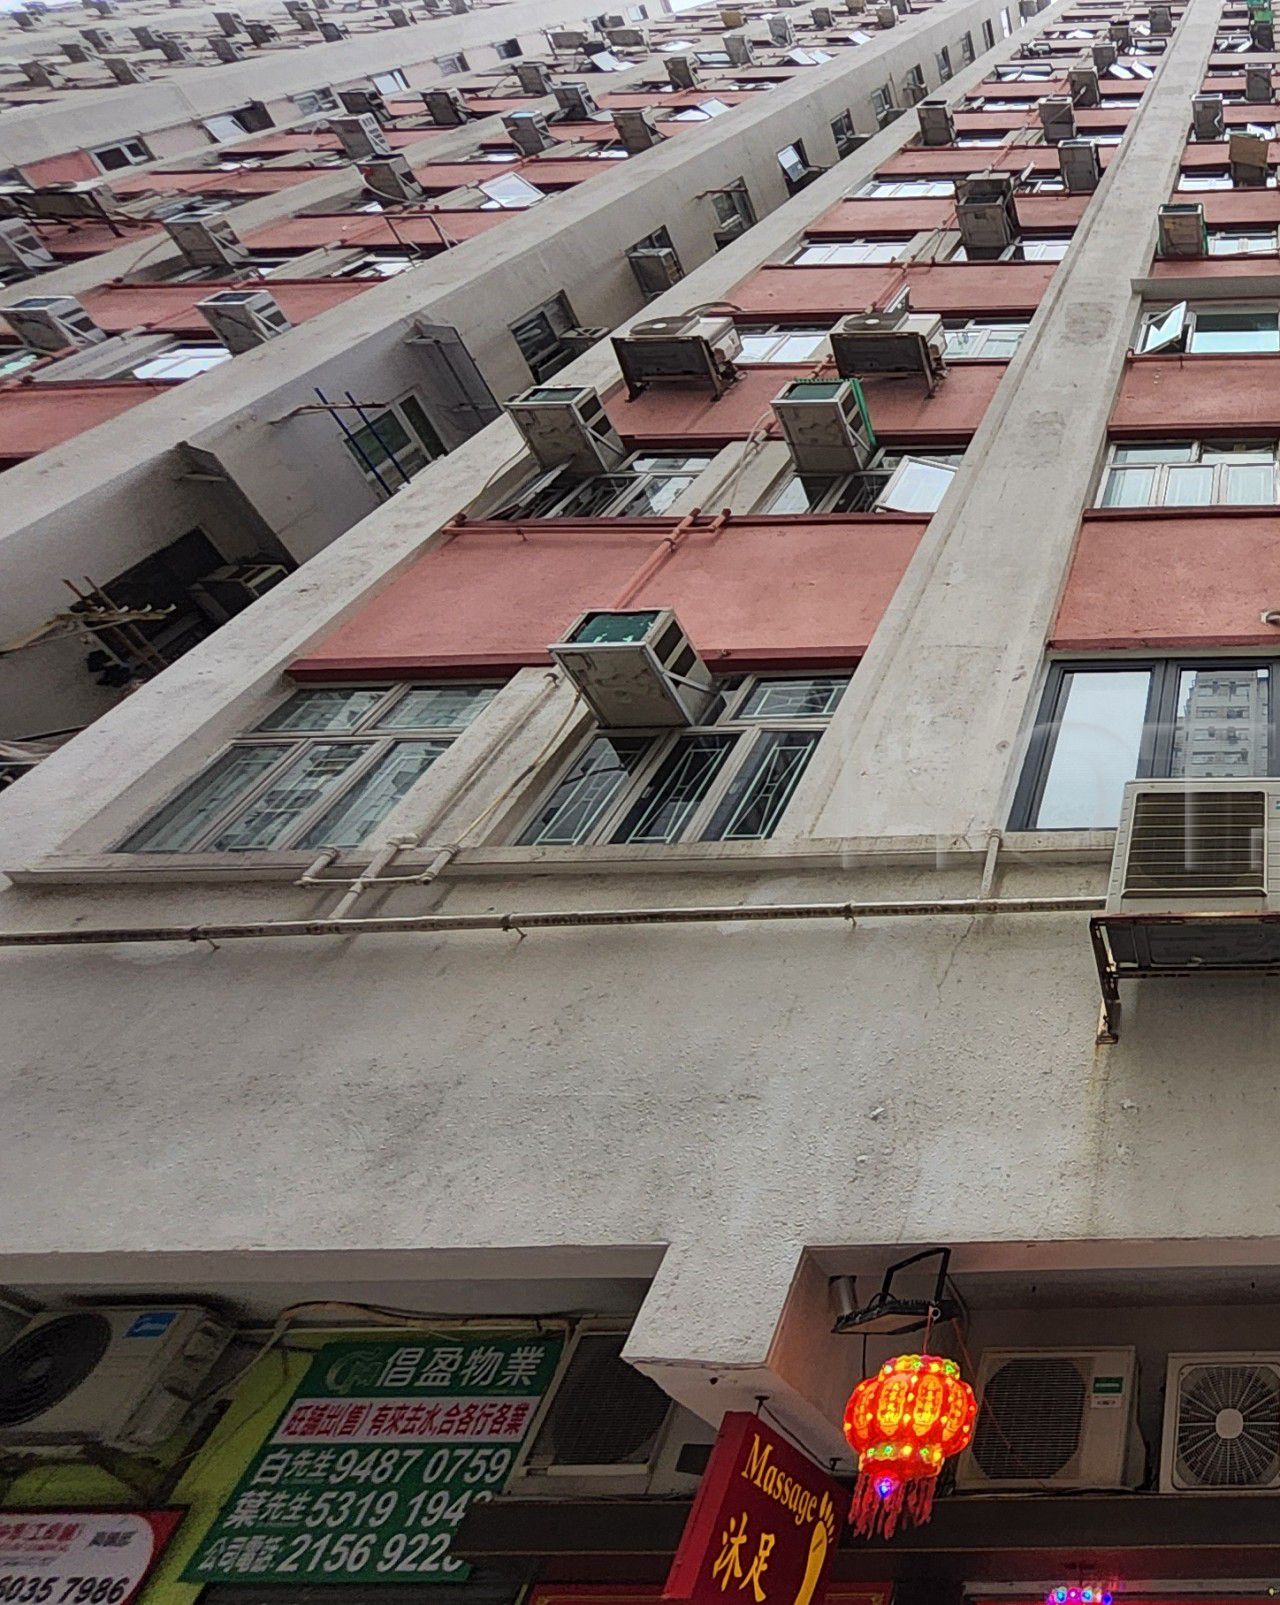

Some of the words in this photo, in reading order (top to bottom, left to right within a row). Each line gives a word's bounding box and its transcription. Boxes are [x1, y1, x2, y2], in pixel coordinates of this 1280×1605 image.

[375, 1346, 546, 1387] 倡盈物業
[329, 1449, 423, 1484] 9487
[422, 1449, 512, 1485] 0759
[741, 1433, 817, 1525] Massage
[305, 1490, 398, 1528] 5319
[404, 1490, 492, 1528] 194
[275, 1534, 377, 1573] 2156
[58, 1576, 130, 1604] 7986
